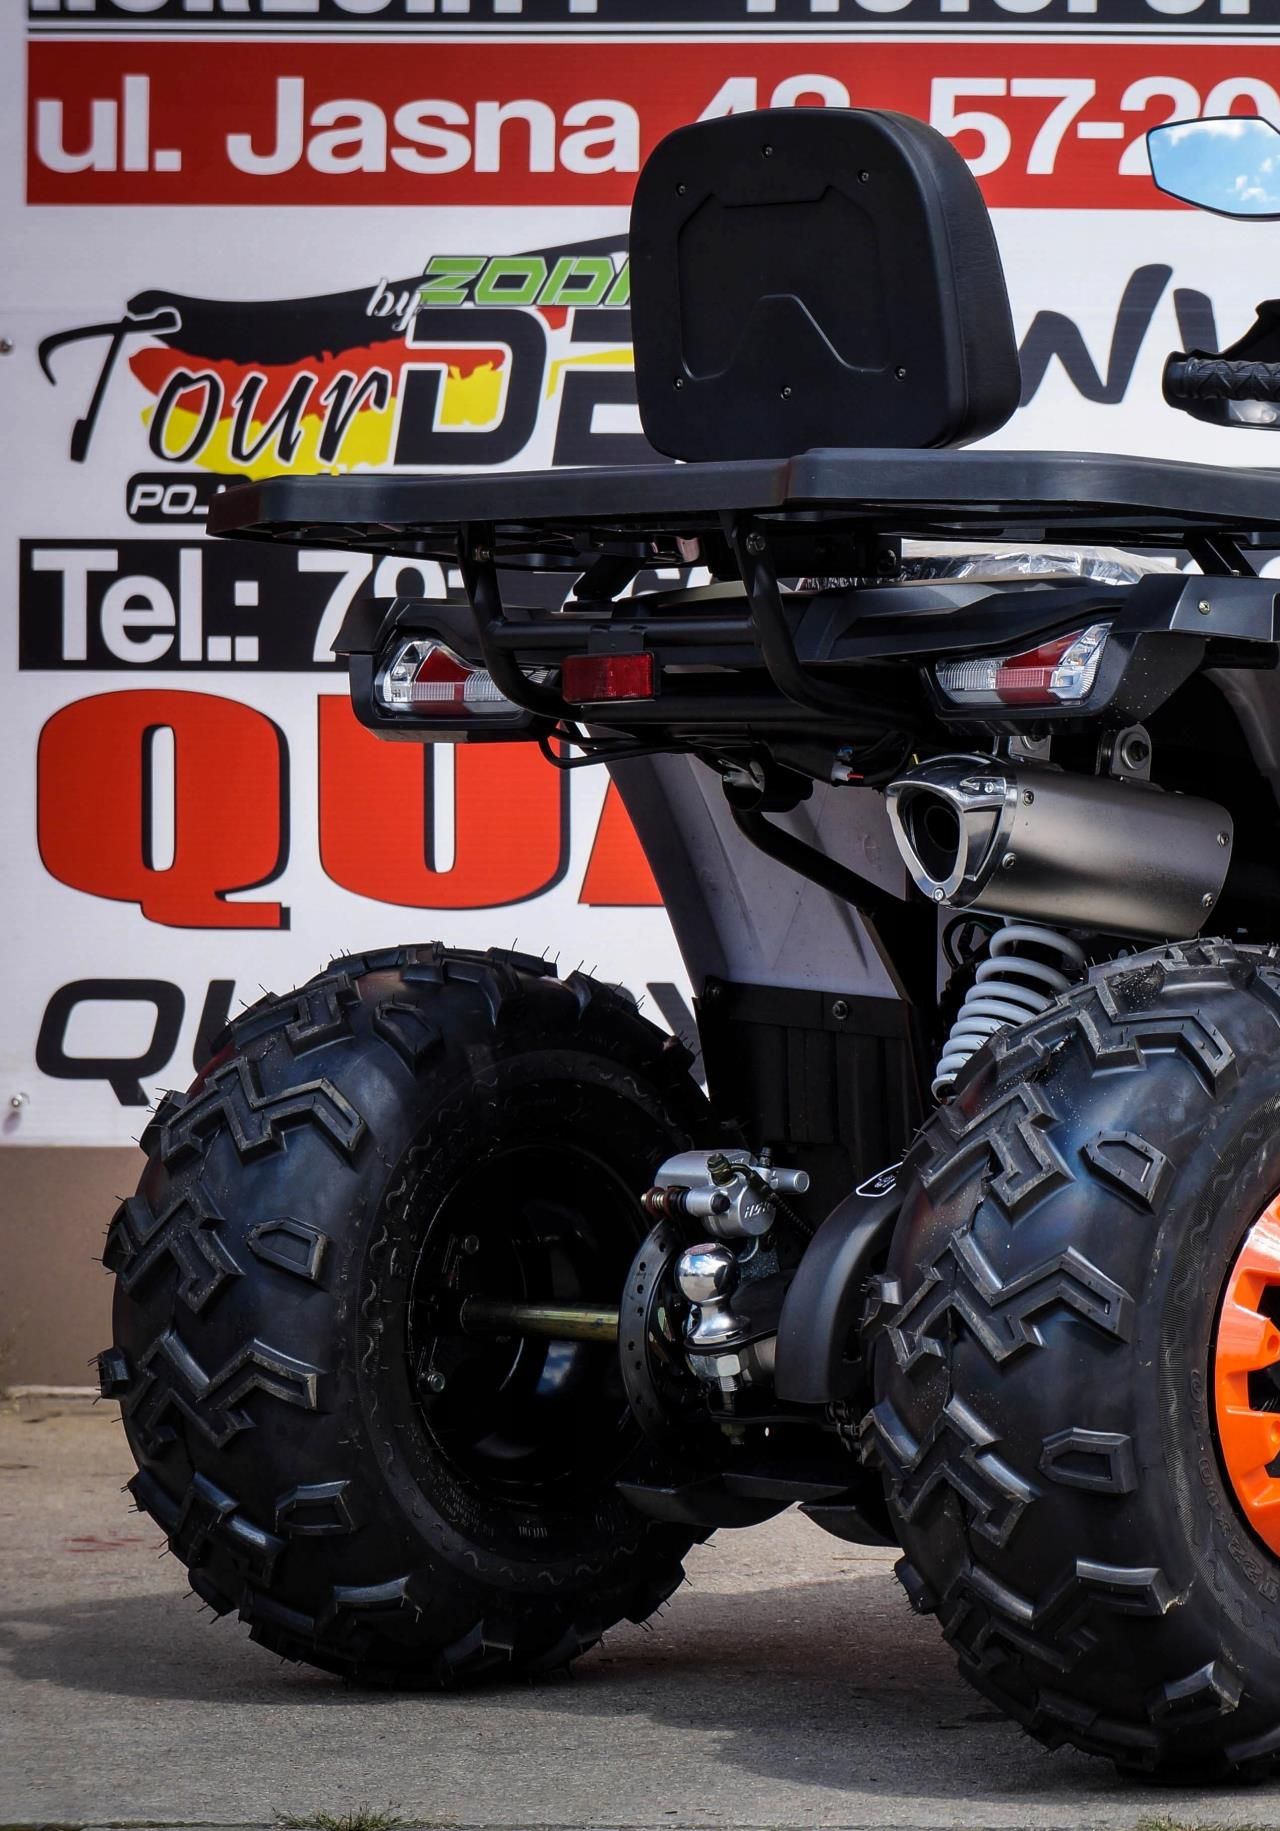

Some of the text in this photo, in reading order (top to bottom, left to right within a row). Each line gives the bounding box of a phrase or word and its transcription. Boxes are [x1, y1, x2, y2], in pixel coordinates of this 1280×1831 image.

[37, 74, 183, 173] ul.
[226, 75, 640, 174] Jasna
[37, 304, 392, 465] Tour
[31, 548, 259, 662] Tel.:
